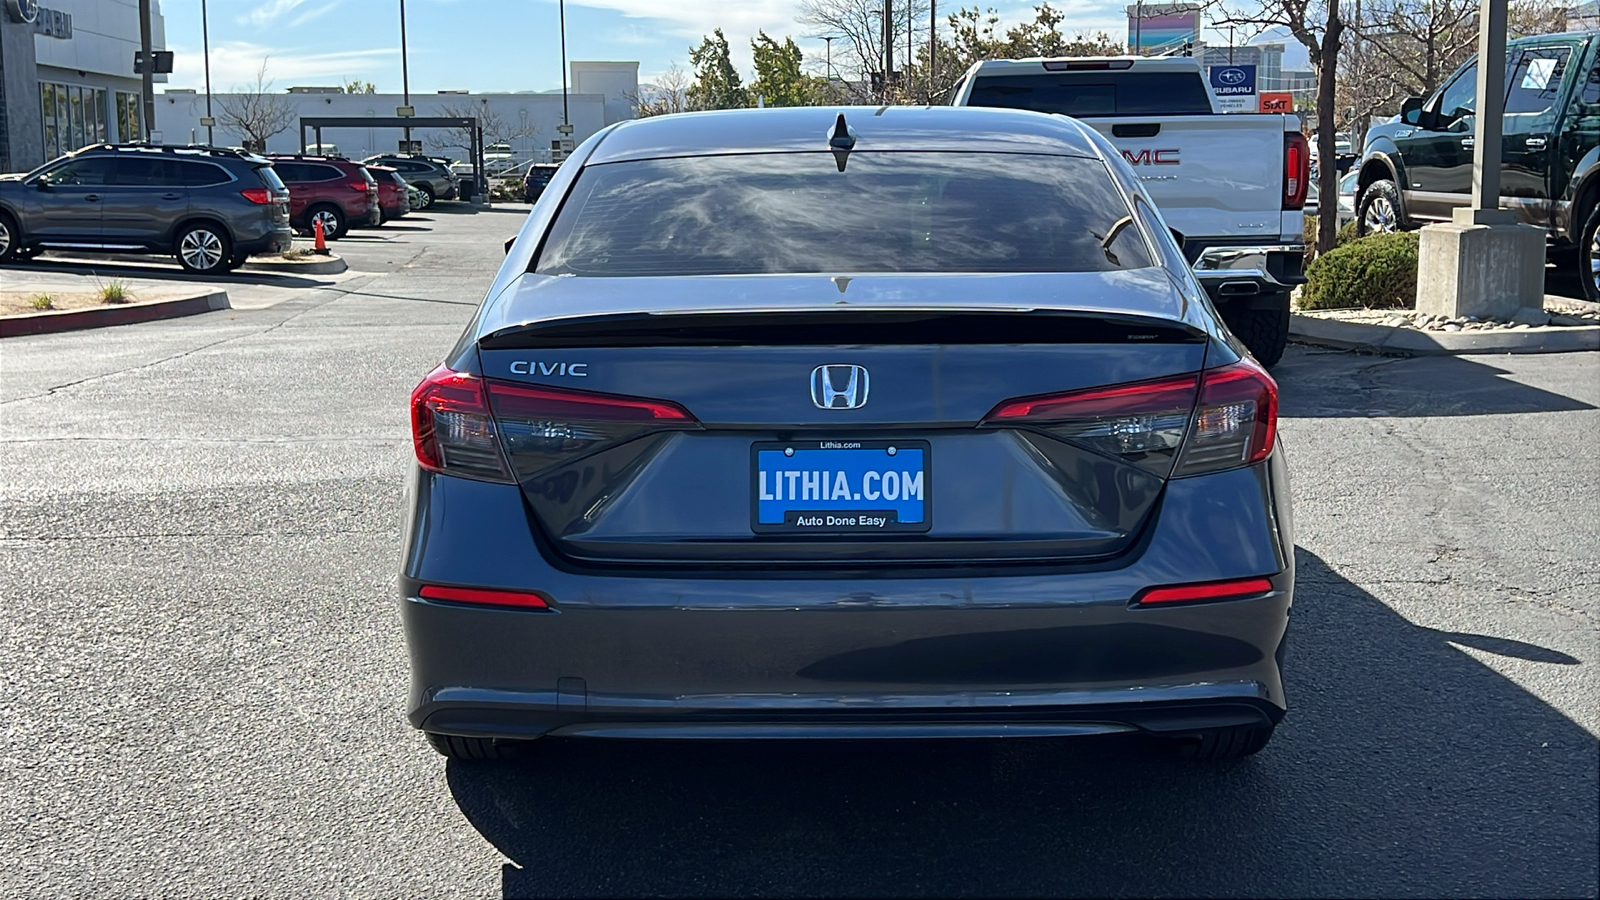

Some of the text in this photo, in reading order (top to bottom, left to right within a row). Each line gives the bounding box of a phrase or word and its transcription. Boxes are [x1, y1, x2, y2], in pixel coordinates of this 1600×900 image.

[1213, 86, 1252, 94] SUBARU
[1121, 148, 1181, 166] MC
[509, 360, 588, 377] CIVIC
[819, 441, 861, 450] Lithia.com
[758, 470, 925, 501] LITHIA.COM
[796, 515, 887, 528] Auto Done Easy
